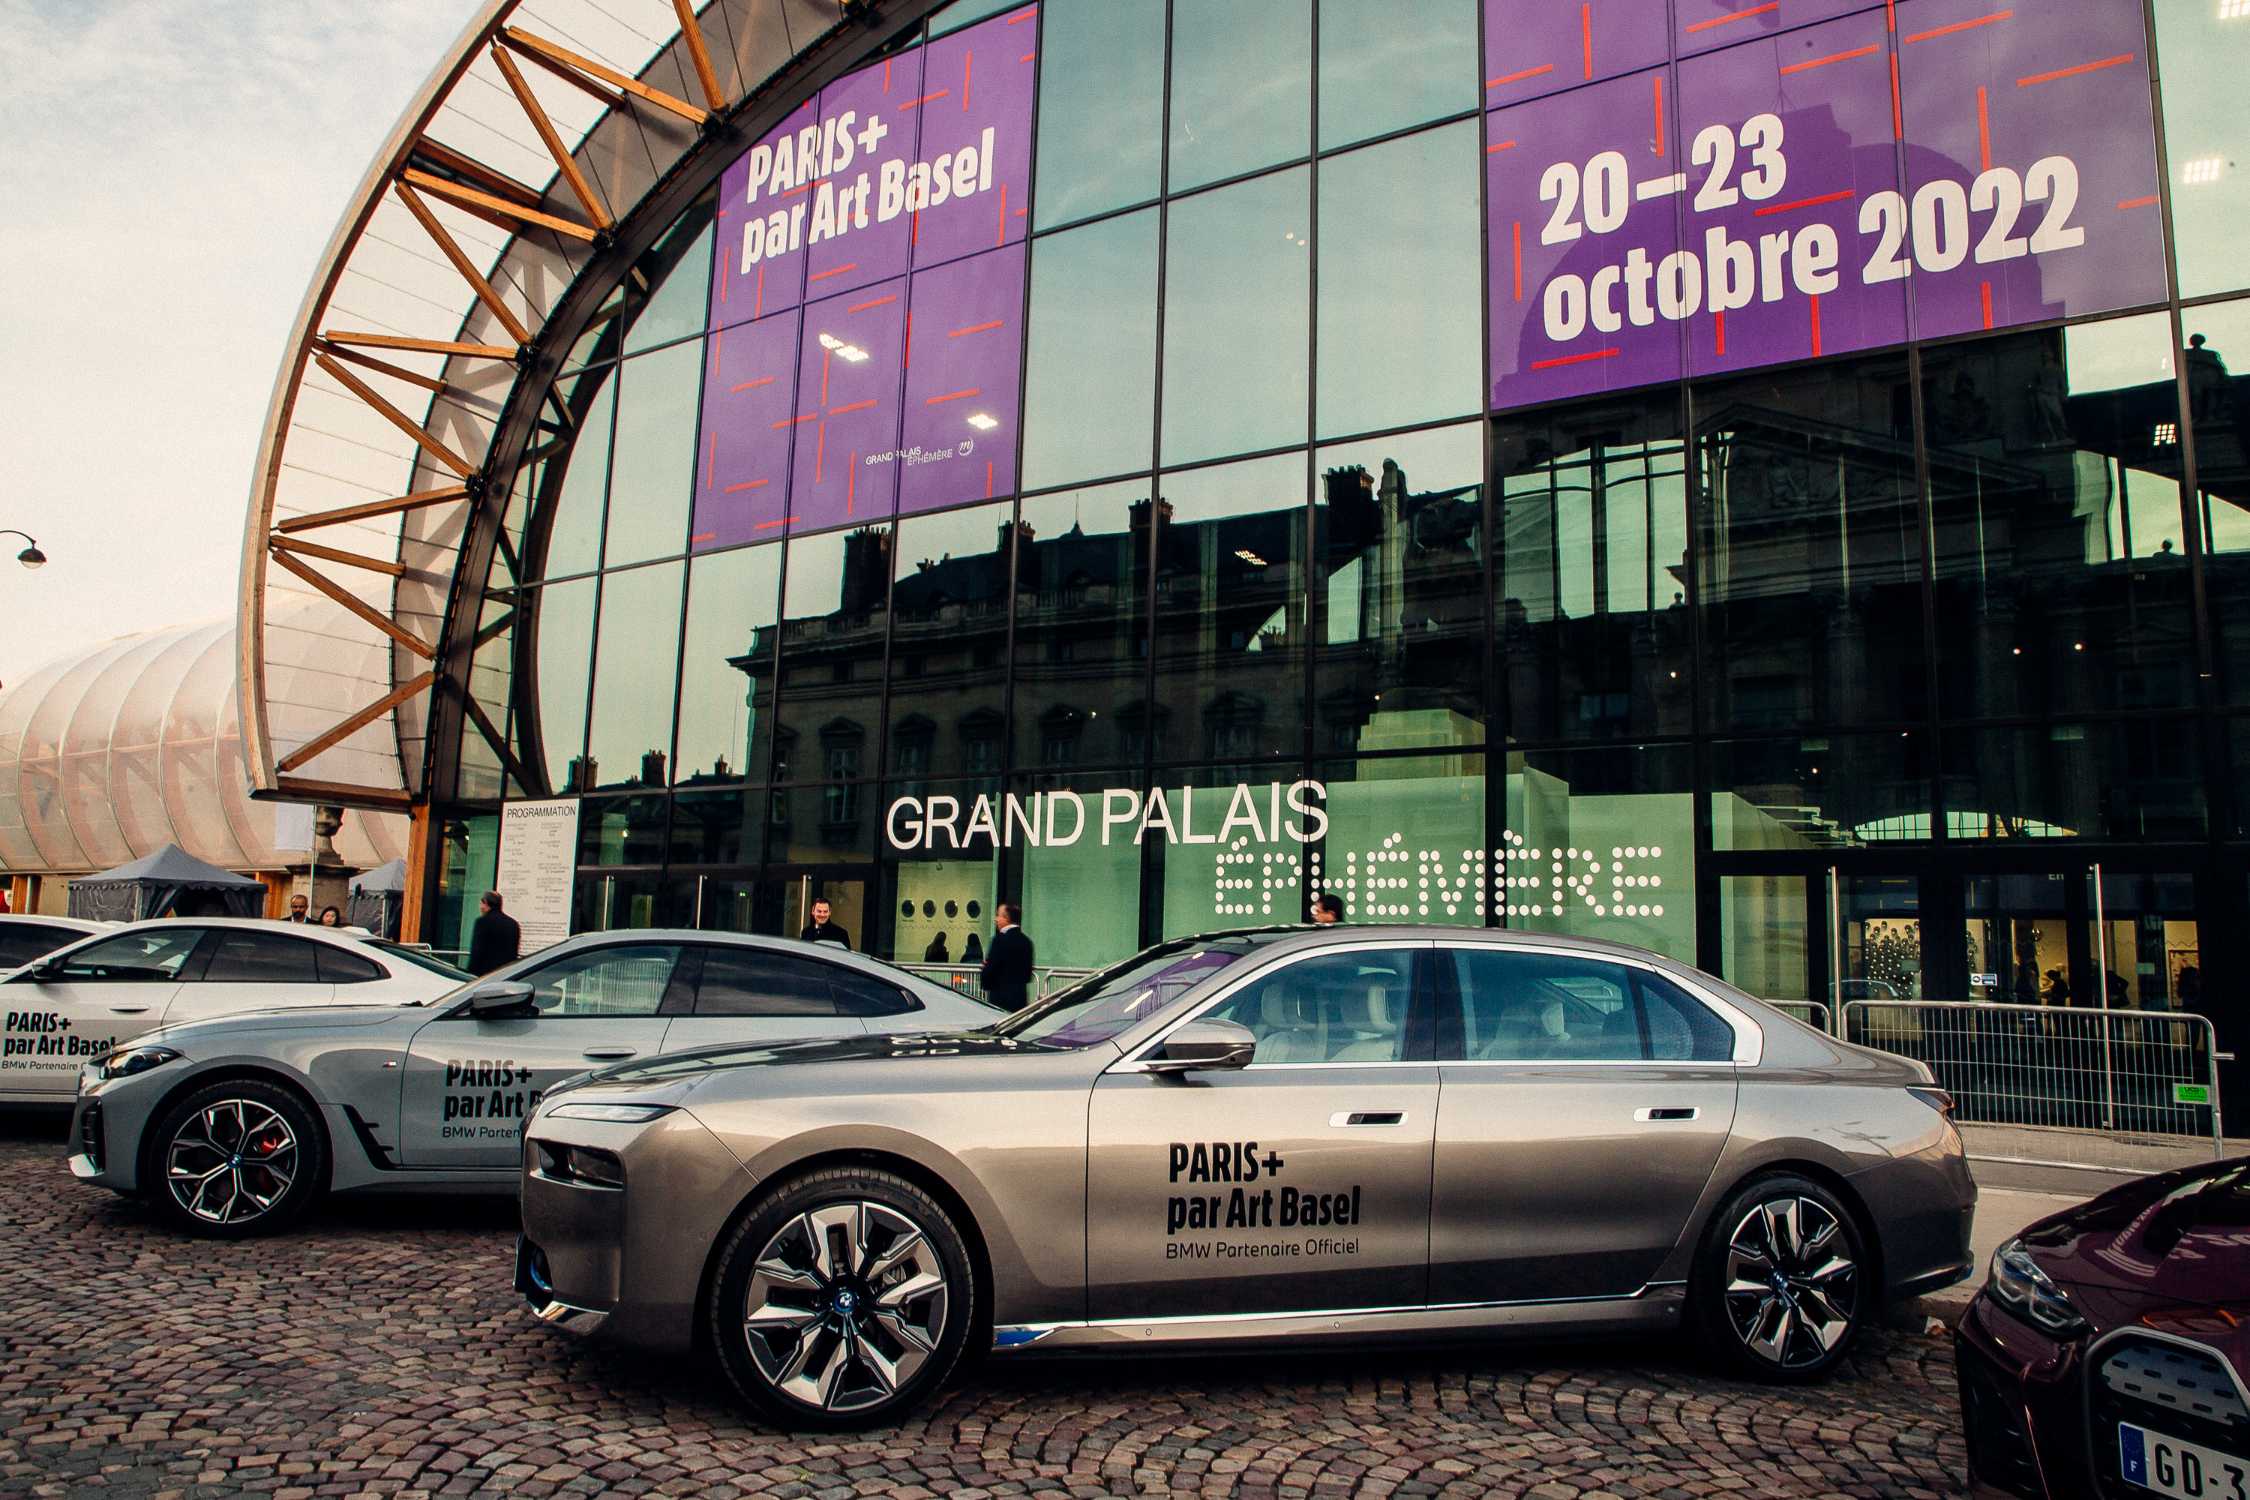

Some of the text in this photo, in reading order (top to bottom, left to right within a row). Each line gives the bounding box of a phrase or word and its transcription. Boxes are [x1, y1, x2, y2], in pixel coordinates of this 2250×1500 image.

[747, 110, 888, 203] PARIS+
[741, 126, 995, 275] par Art Basel
[1543, 155, 2086, 341] octobre 2022
[866, 451, 893, 465] GRAND
[507, 805, 577, 818] PROGRAMMATION
[886, 780, 1329, 849] GRAND PALAIS
[1215, 829, 1664, 916] ÉPHÉMÈRE
[6, 1011, 72, 1032] PARIS+
[3, 1038, 35, 1057] par
[36, 1035, 65, 1056] Art
[1, 1060, 28, 1070] BMW
[29, 1061, 79, 1071] Partenaire
[446, 1059, 533, 1088] PARIS+
[443, 1095, 485, 1121] par
[487, 1090, 524, 1118] Art
[442, 1126, 521, 1138] BMW Parten
[1169, 1141, 1285, 1183] PARIS+
[1167, 1185, 1361, 1235] par Art Basel
[1166, 1237, 1360, 1260] BMW Partenaire Officiel
